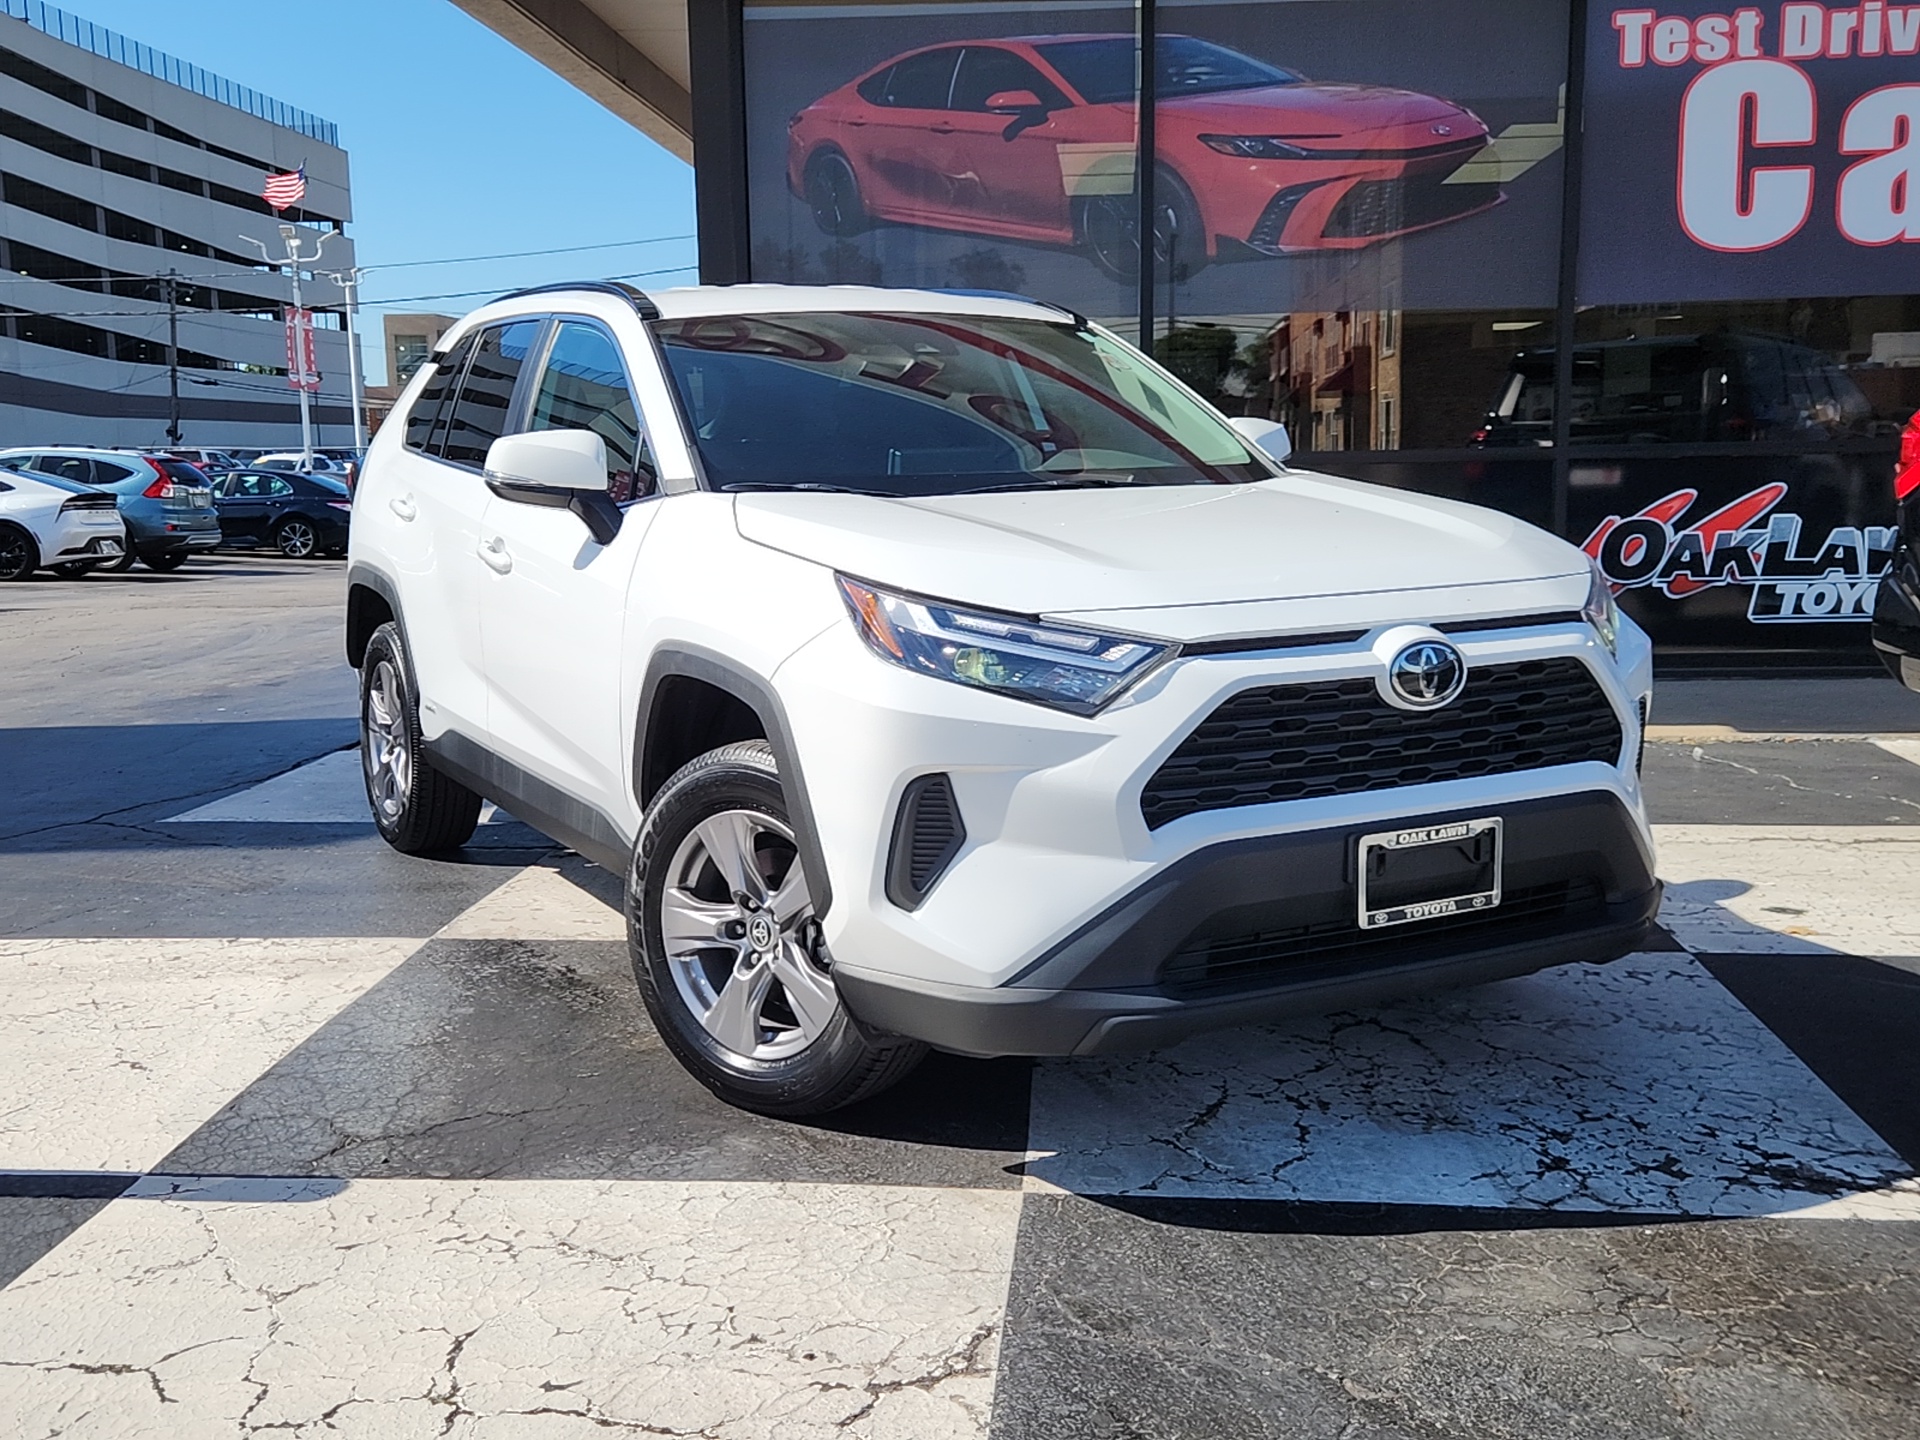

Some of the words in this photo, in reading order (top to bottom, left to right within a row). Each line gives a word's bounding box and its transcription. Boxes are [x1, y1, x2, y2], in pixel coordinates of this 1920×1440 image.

[1612, 9, 1764, 67] Test
[1677, 58, 1920, 252] Ca
[1398, 831, 1428, 844] OAK
[1429, 825, 1468, 840] LAWN
[1403, 900, 1457, 919] TOYOTA
